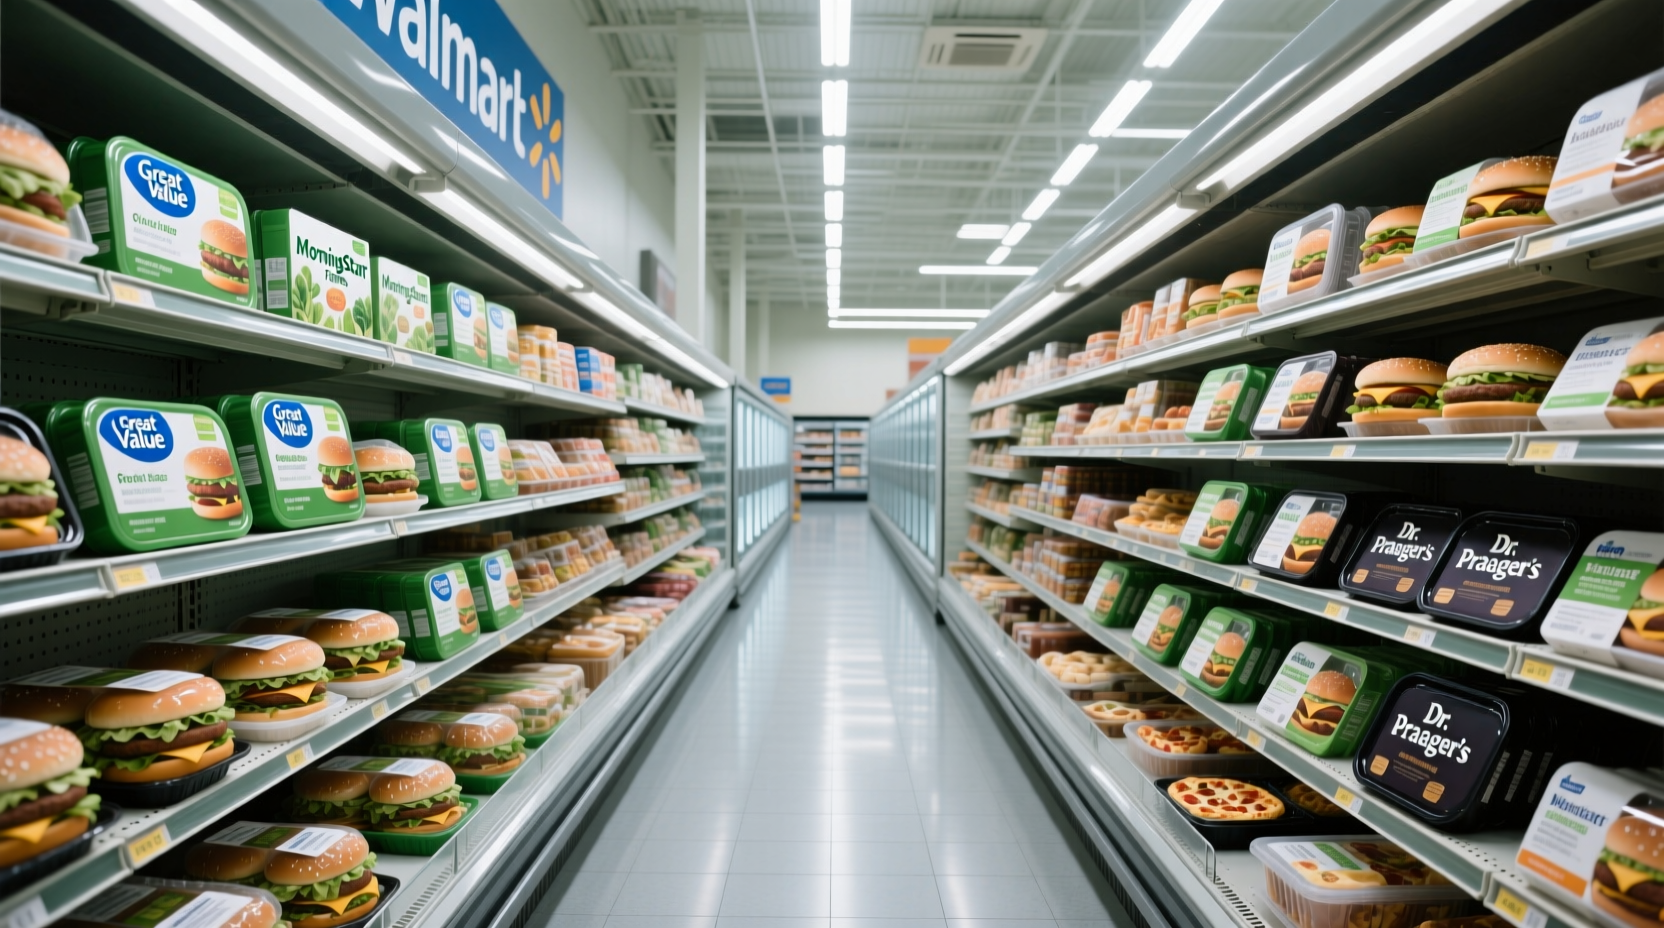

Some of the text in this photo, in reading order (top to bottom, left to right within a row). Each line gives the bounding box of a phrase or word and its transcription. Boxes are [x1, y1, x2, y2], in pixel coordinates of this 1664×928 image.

[350, 0, 527, 160] almart
[138, 159, 183, 191] Great
[111, 417, 166, 449] Value
[1396, 521, 1421, 541] Dr.
[1489, 533, 1519, 556] Dr.
[1422, 702, 1451, 731] Dr.
